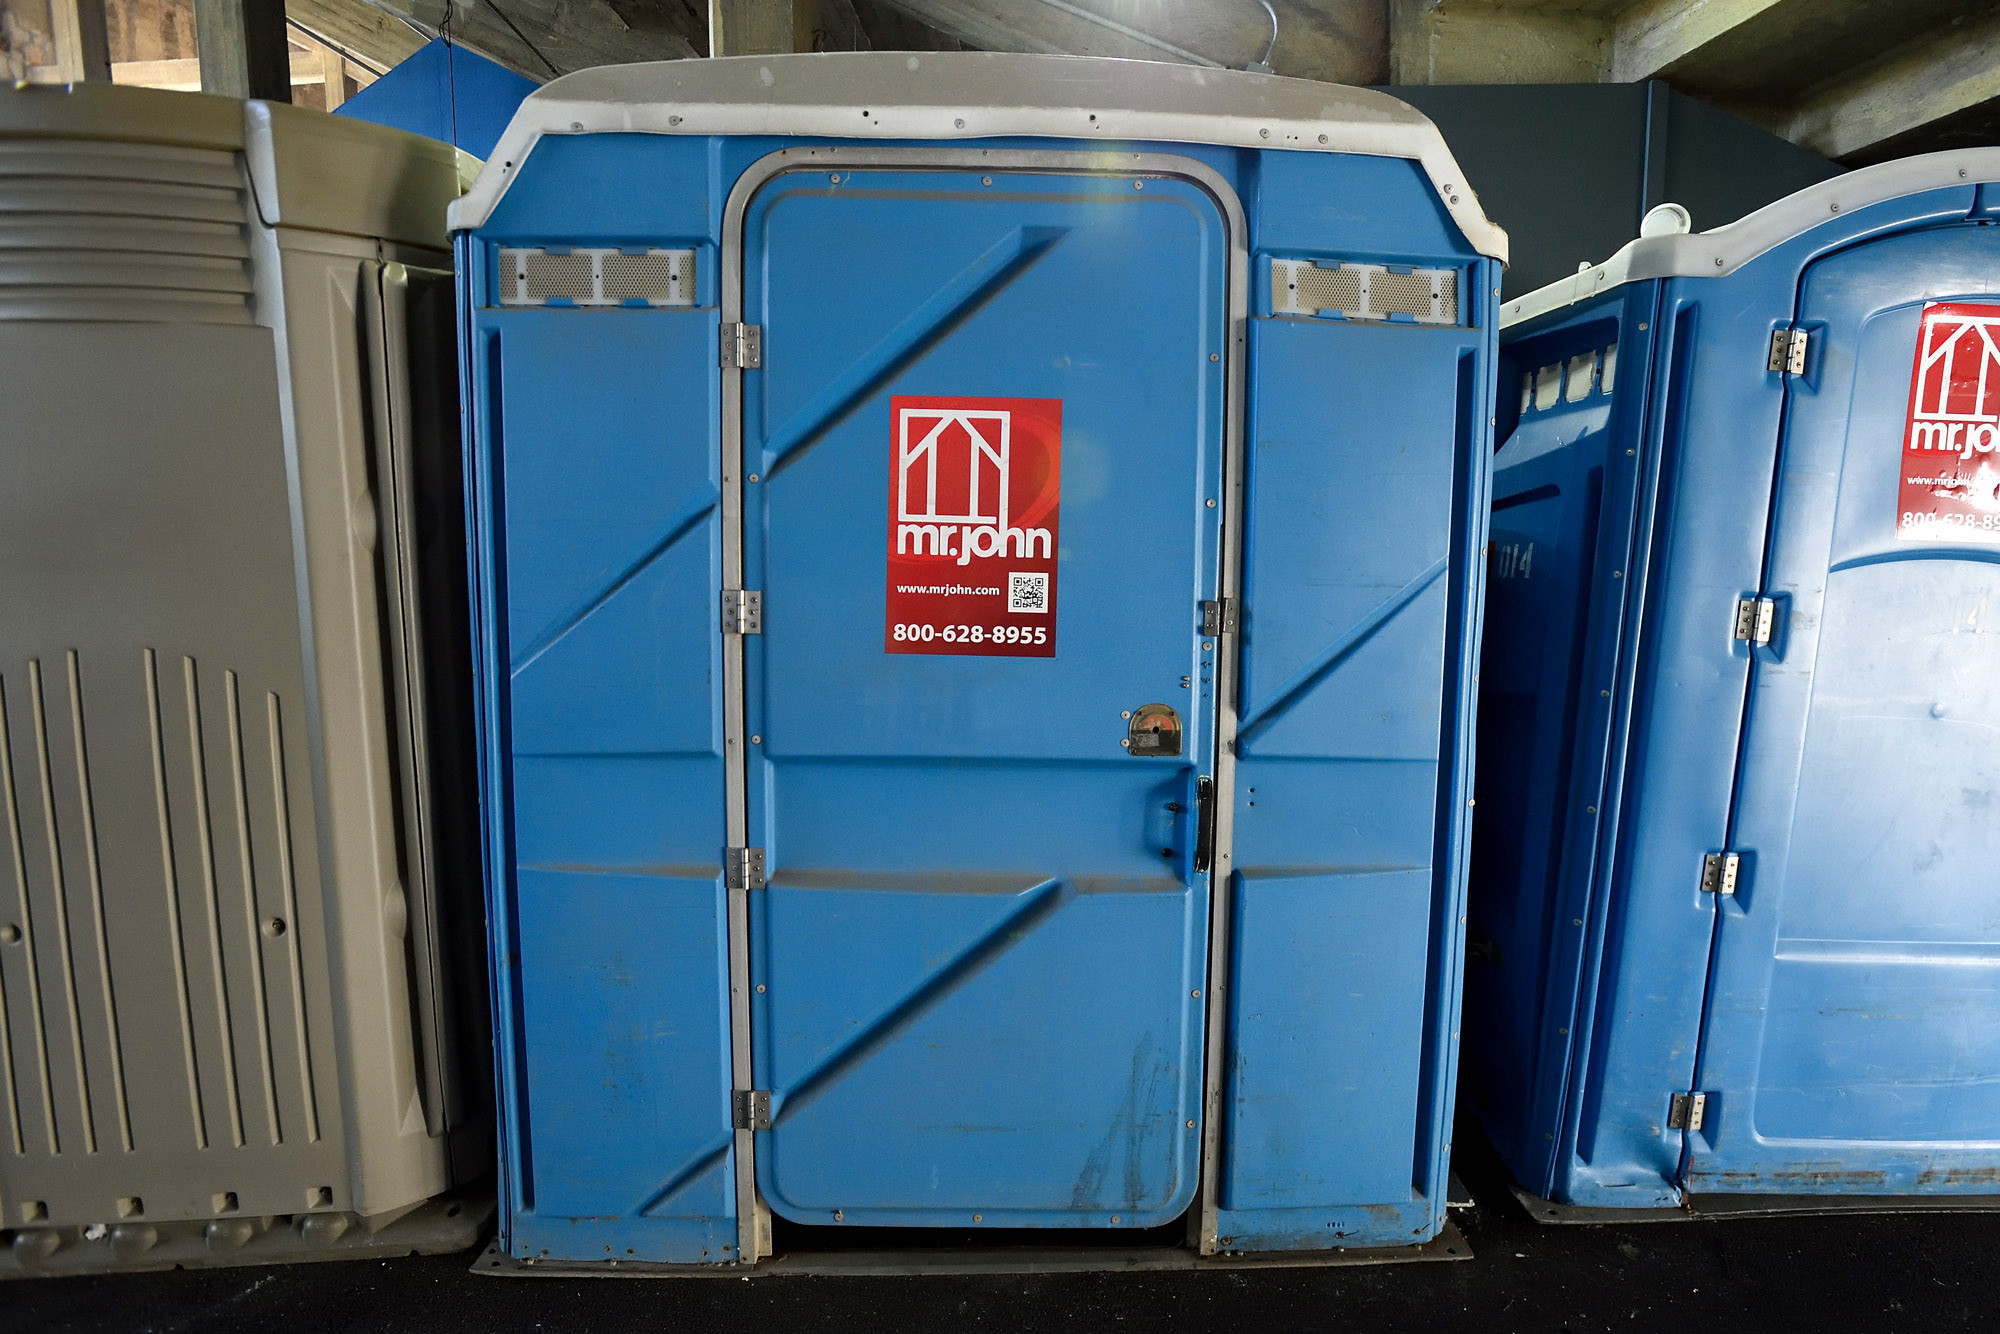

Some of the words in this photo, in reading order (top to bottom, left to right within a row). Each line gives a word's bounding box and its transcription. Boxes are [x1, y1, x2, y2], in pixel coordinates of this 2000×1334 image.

[1910, 421, 2000, 460] mr.jo
[897, 523, 1052, 566] mr.john
[897, 582, 1000, 597] www.mrjohn.com
[893, 623, 1047, 645] 800-628-8955
